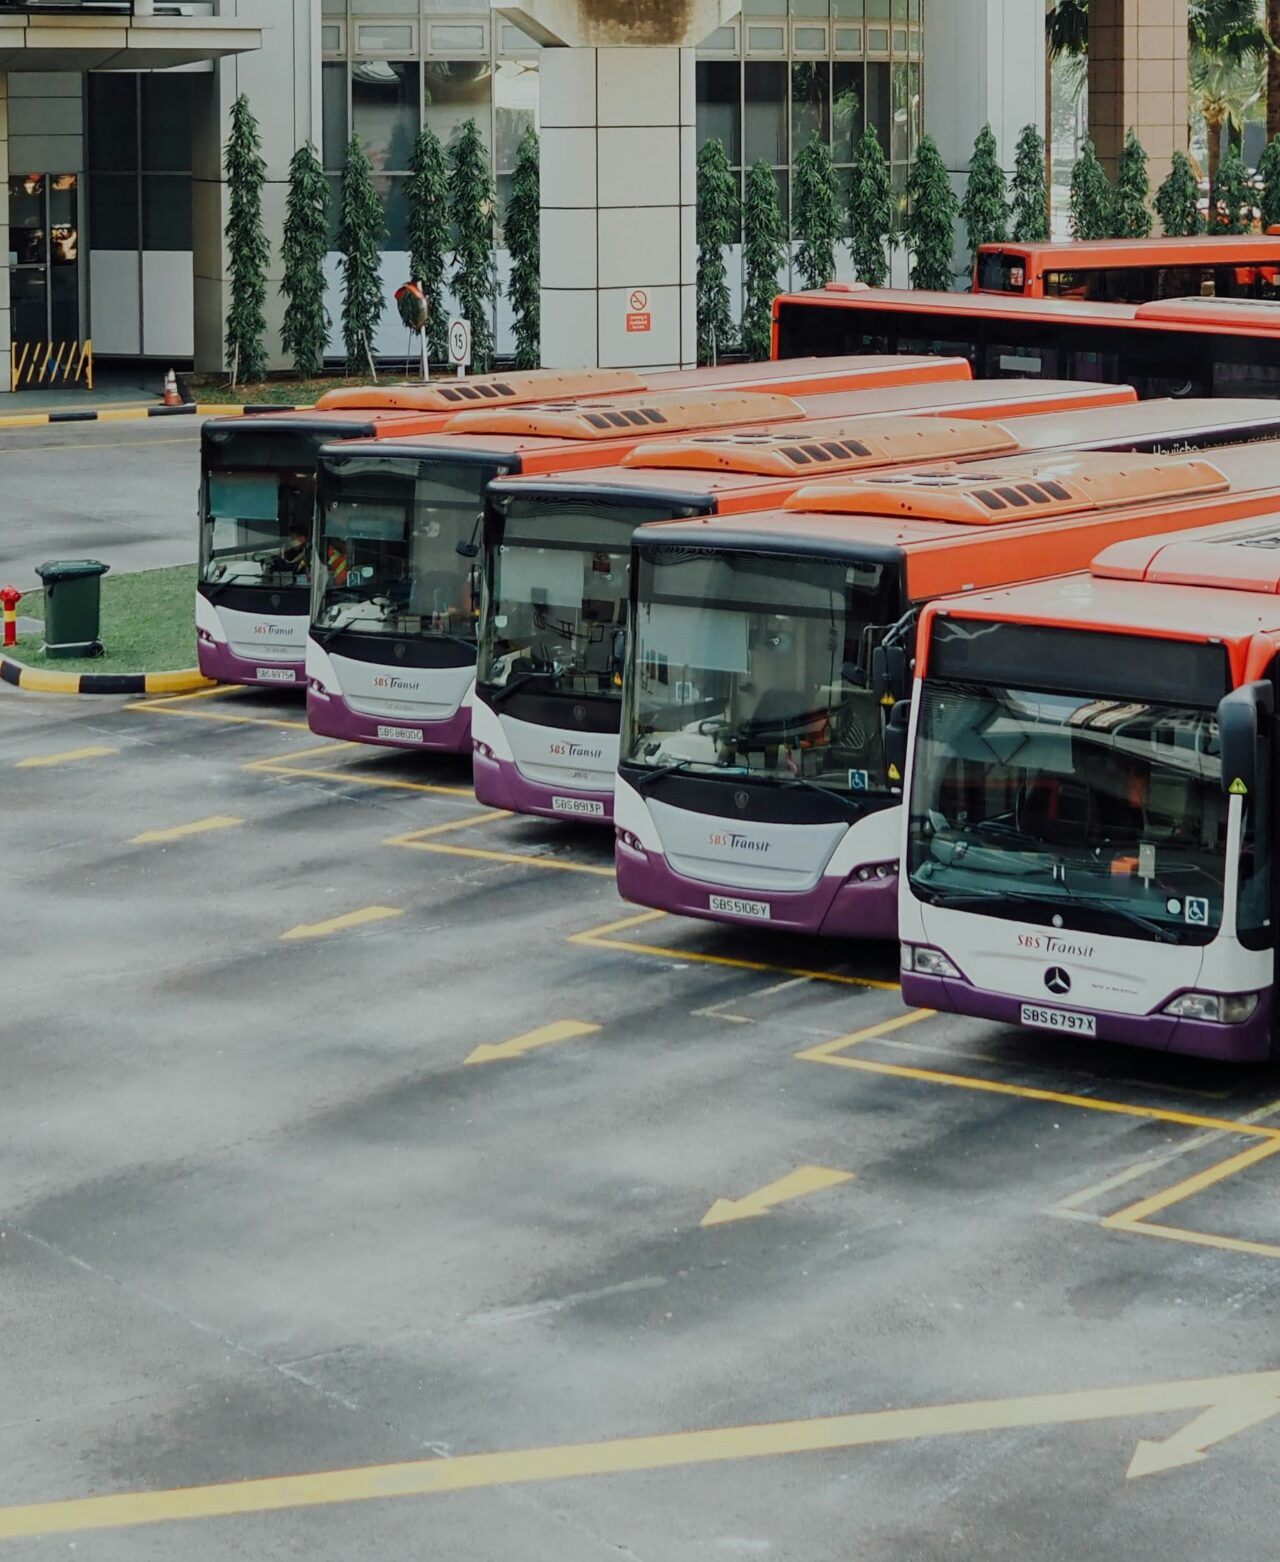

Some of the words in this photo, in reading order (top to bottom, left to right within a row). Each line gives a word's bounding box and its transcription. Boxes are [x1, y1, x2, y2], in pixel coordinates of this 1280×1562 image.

[454, 333, 463, 350] 15
[374, 677, 388, 688] SBS
[390, 677, 420, 691] Transit
[550, 743, 565, 755] SBS
[567, 743, 602, 759] Transit
[555, 798, 602, 815] SBS8913P
[709, 834, 727, 847] SBS
[728, 832, 771, 852] Transit
[1017, 934, 1041, 949] SBS
[1042, 935, 1096, 958] Transit
[1022, 1007, 1095, 1032] SBS6797X
